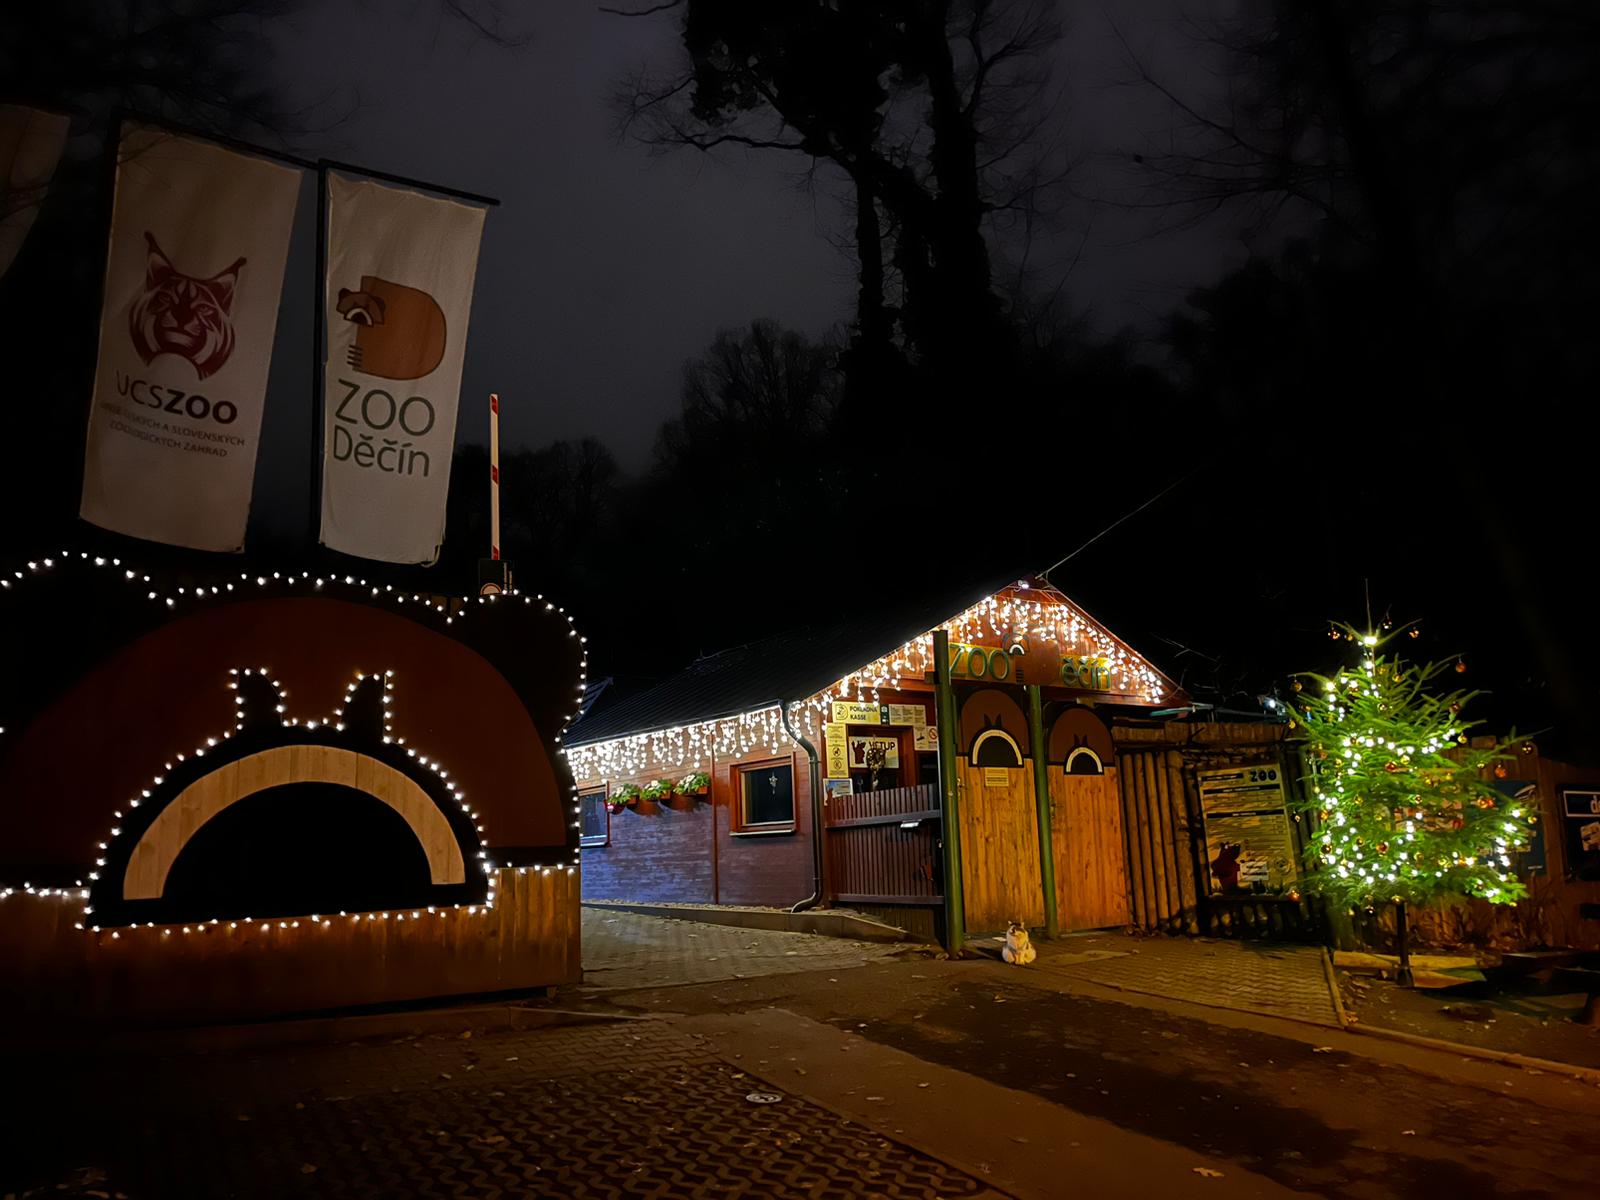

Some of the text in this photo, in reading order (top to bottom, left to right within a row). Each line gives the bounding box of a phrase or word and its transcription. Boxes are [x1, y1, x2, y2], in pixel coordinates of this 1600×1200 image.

[335, 378, 435, 437] ZOO
[333, 425, 430, 478] Děčín
[948, 642, 1010, 680] ZOO
[1250, 770, 1277, 782] ZOO
